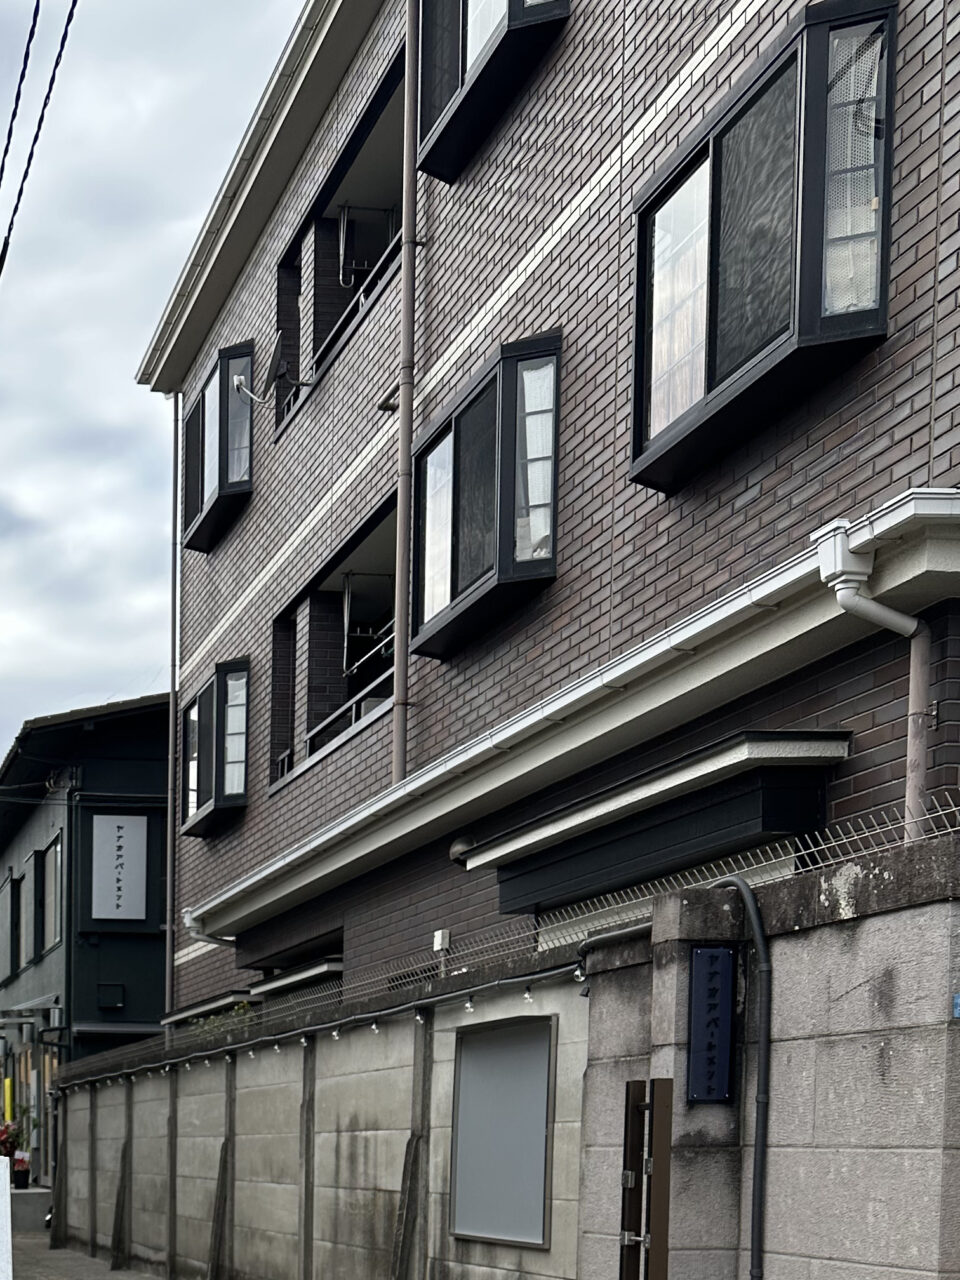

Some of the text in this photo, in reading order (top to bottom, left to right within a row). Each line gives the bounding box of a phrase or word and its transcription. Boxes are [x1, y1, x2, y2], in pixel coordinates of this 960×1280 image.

[115, 825, 125, 910] ヤナカアパートメント
[705, 953, 721, 1096] ヤナカアパートメント
